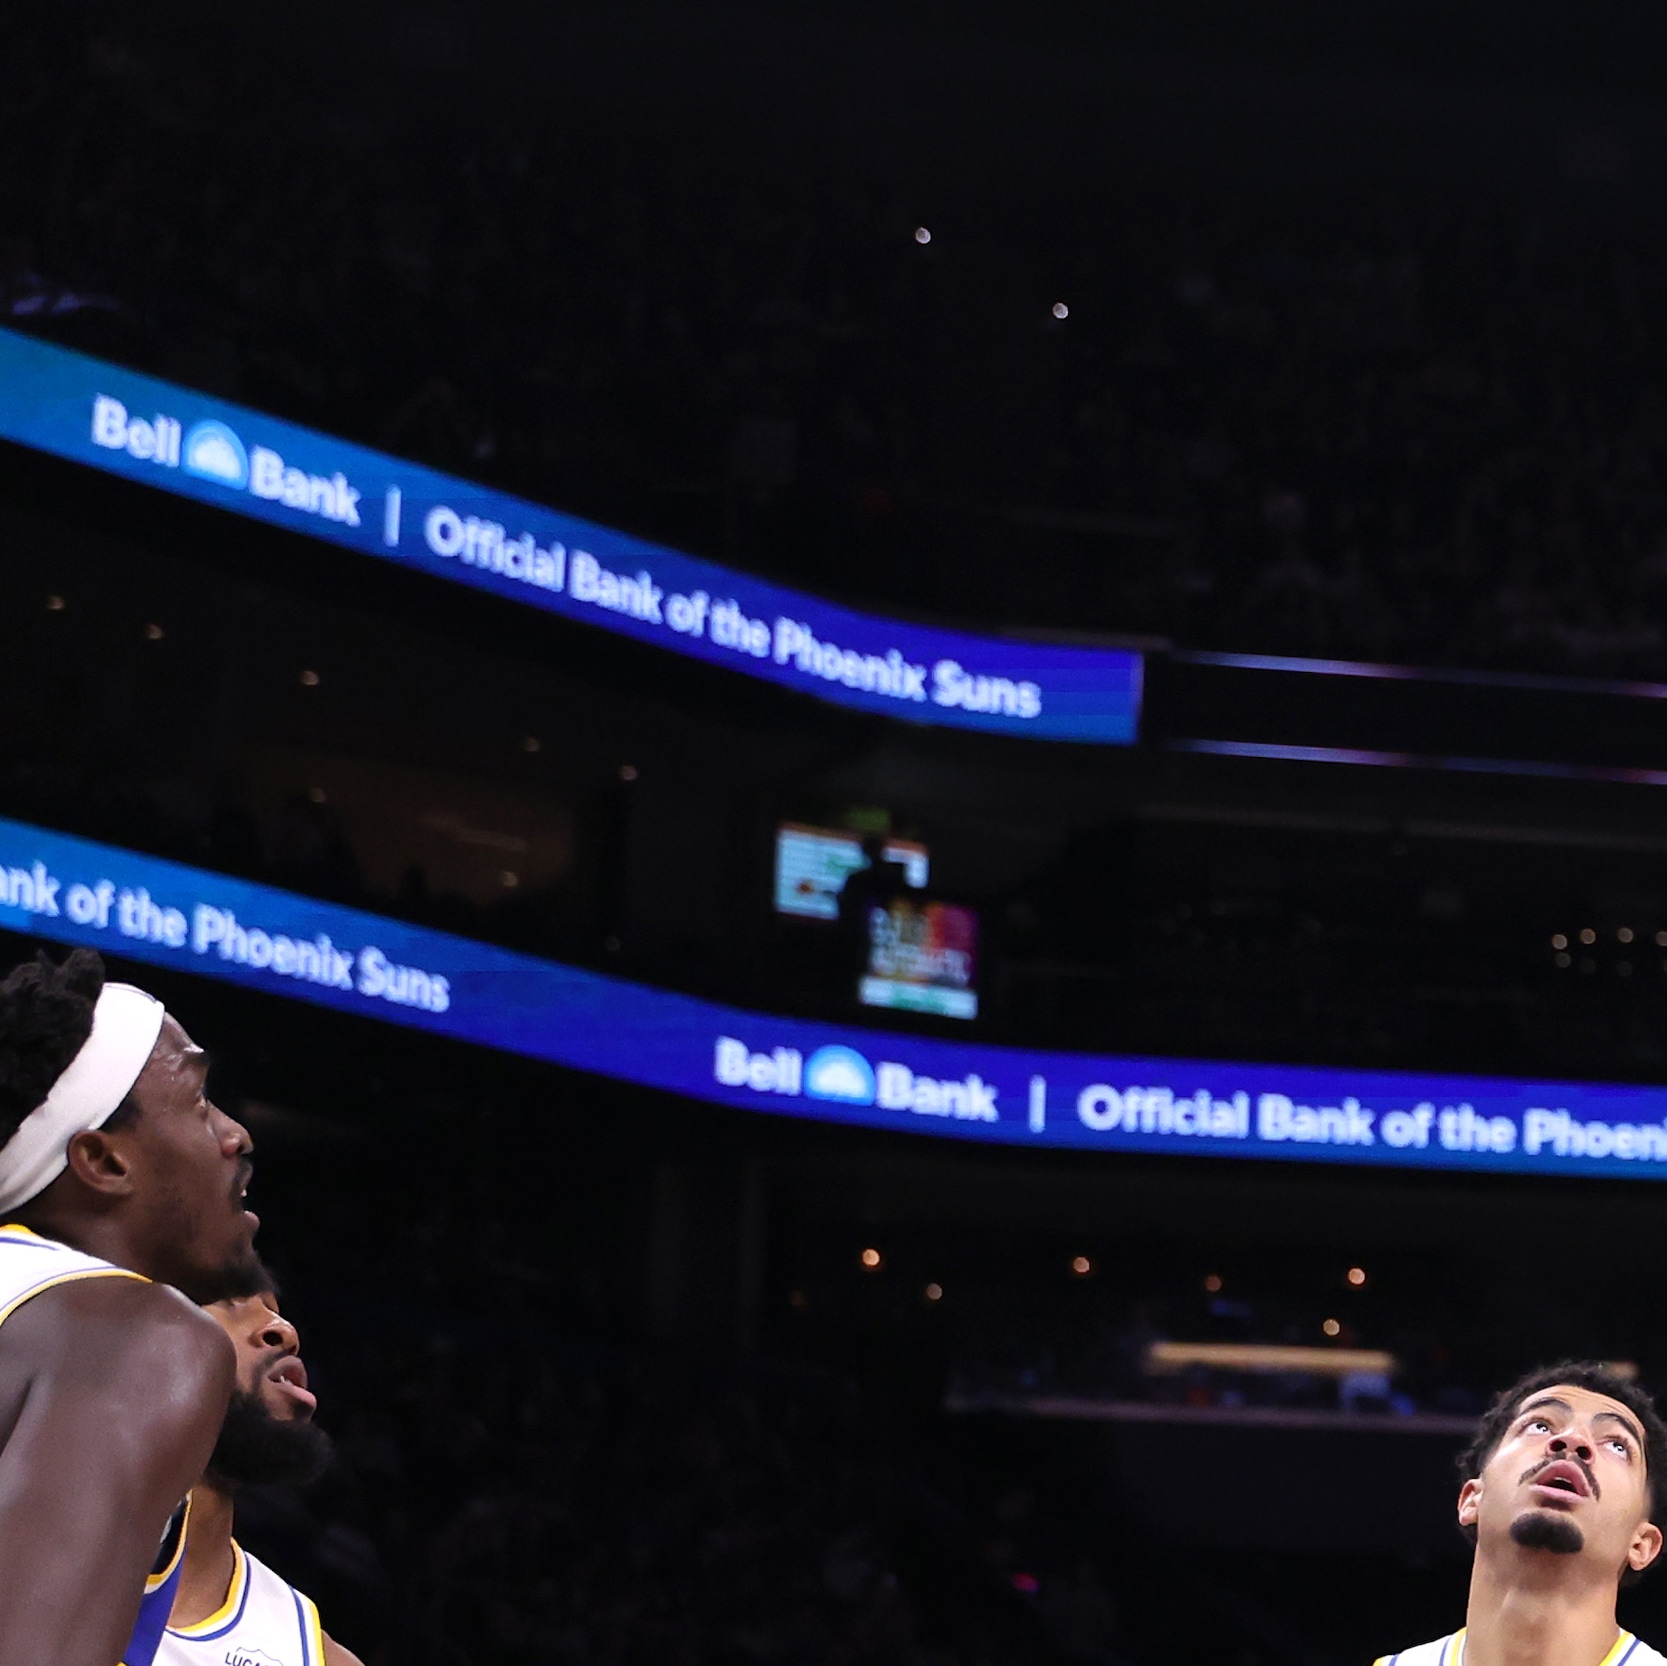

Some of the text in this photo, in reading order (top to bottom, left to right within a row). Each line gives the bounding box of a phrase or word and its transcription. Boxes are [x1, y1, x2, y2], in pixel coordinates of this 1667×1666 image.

[93, 397, 1041, 718] Bell Bank Official Bank of the Phoenix Suns
[0, 866, 449, 1011] nk of the Phoenix Suns
[715, 1038, 802, 1093] Bell
[876, 1061, 997, 1121] Bank
[1079, 1084, 1249, 1136] Official
[1258, 1093, 1373, 1142] Bank
[1382, 1105, 1434, 1147] of
[1439, 1106, 1516, 1152] the
